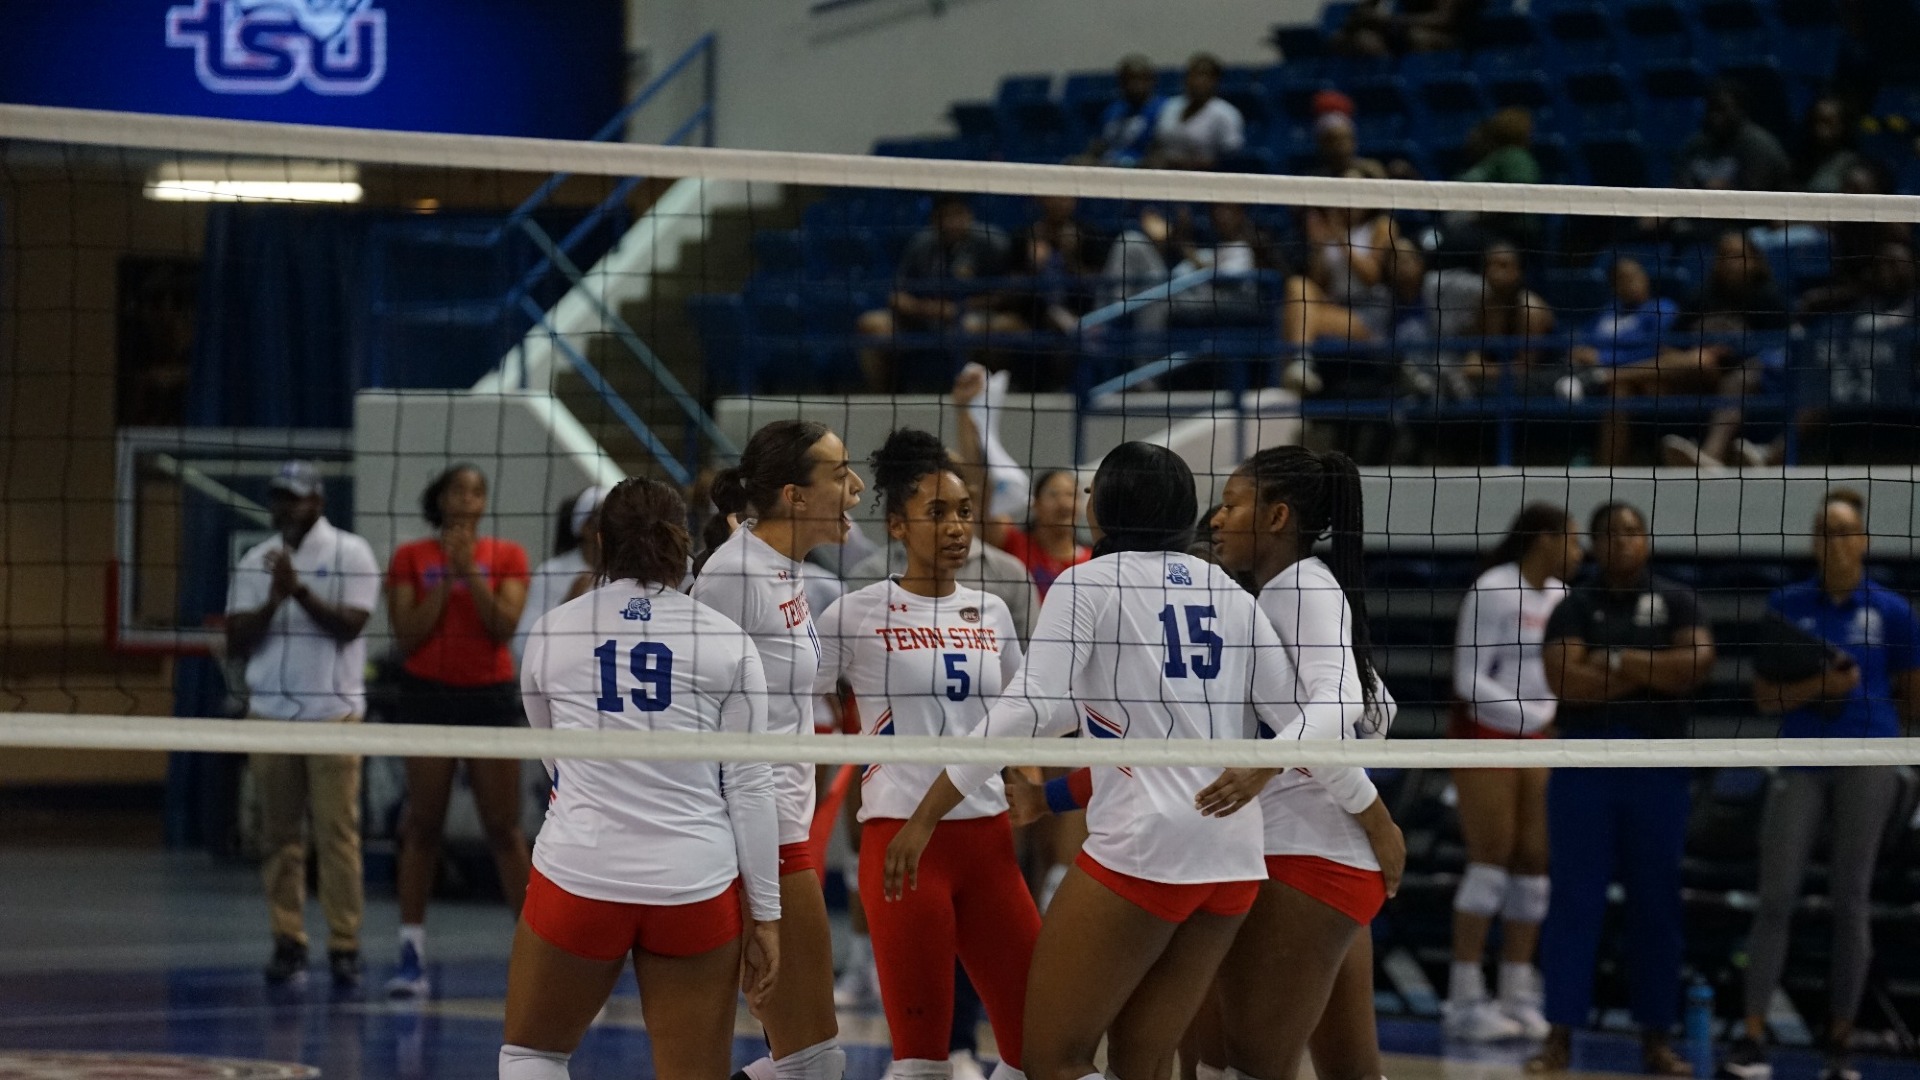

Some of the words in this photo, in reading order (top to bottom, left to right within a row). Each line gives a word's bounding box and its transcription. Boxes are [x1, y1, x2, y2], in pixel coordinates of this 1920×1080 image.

[875, 627, 945, 652] TENN
[948, 627, 998, 652] STATE
[1158, 604, 1223, 679] 15
[594, 640, 673, 712] 19
[943, 653, 970, 702] 5
